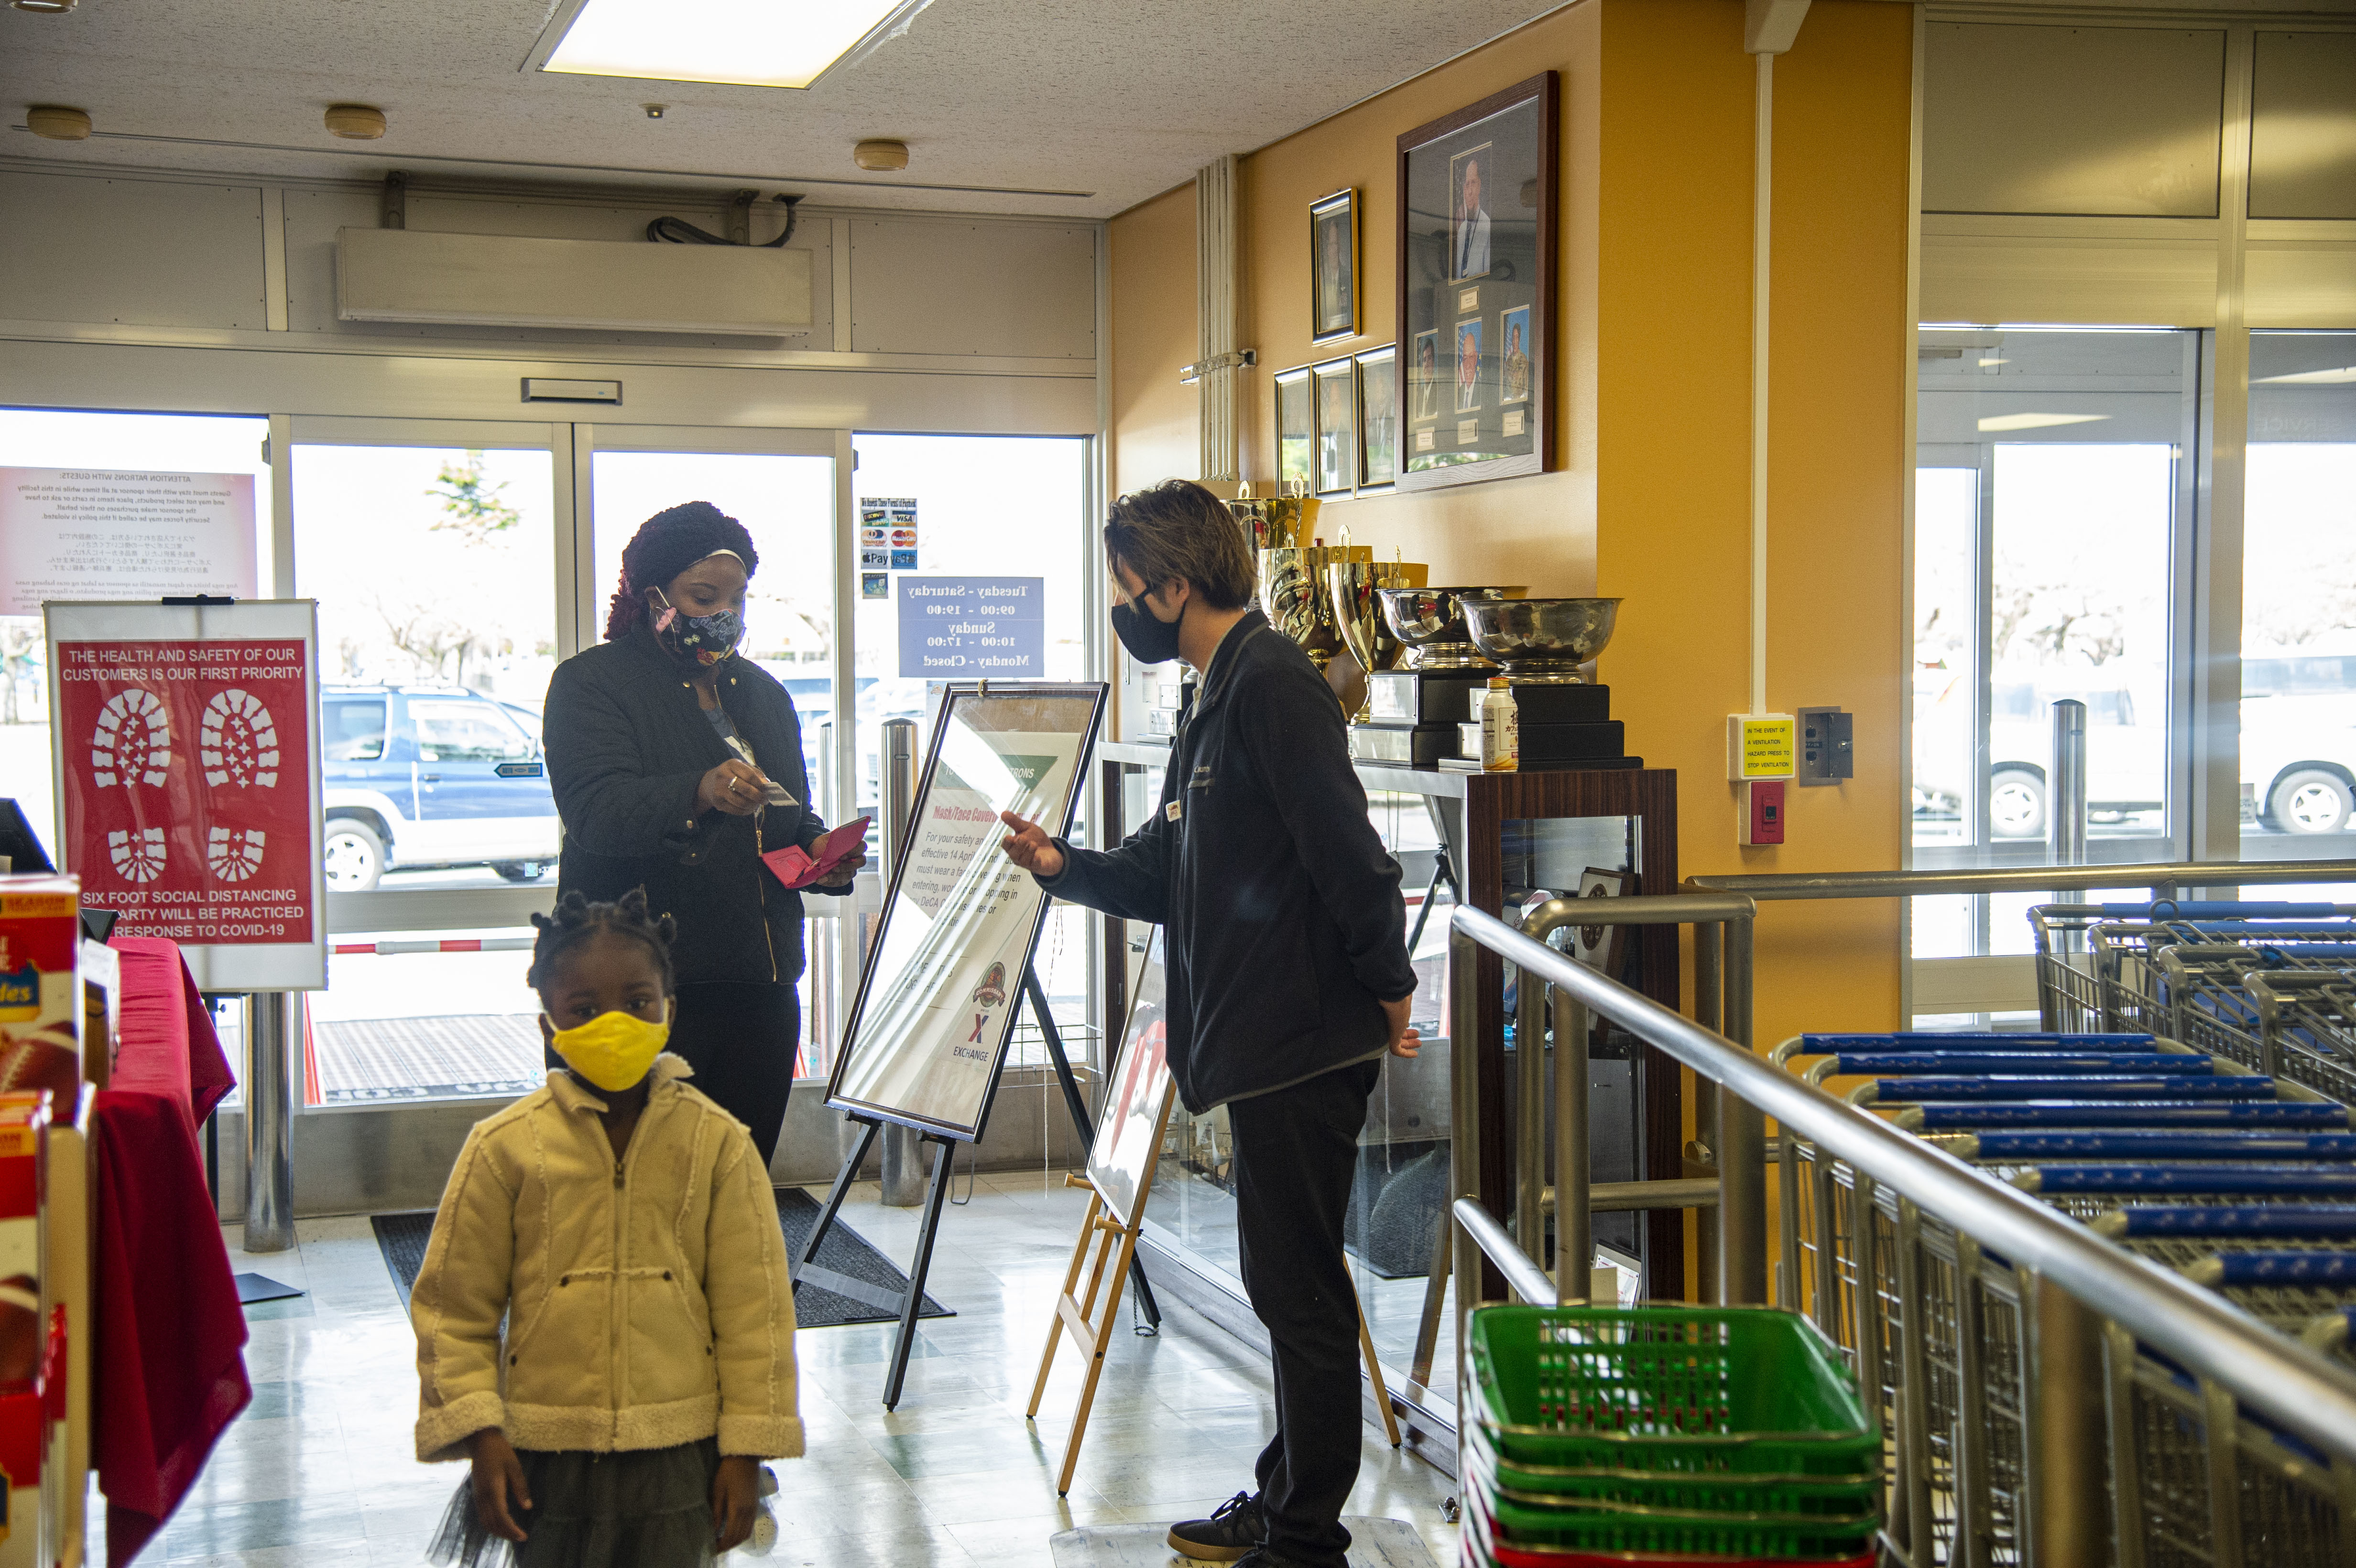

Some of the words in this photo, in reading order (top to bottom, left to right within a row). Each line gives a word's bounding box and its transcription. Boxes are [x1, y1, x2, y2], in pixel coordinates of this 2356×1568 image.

[871, 553, 888, 566] Pay
[69, 650, 96, 663] THE
[99, 650, 153, 662] HEALTH
[157, 650, 185, 662] AND
[189, 649, 240, 662] SAFETY
[244, 648, 262, 661] OF
[266, 648, 295, 661] OUR
[63, 668, 148, 681] CUSTOMERS
[152, 668, 164, 680] IS
[167, 668, 196, 680] OUR
[200, 667, 238, 680] FIRST
[241, 666, 303, 679] PRIORITY
[1010, 767, 1035, 779] TRONS
[932, 806, 971, 822] Mask/Face
[971, 807, 998, 823] Coveri
[926, 831, 937, 841] For
[937, 835, 953, 845] your
[954, 834, 974, 847] safety
[975, 837, 986, 846] an
[922, 848, 949, 859] effective
[950, 850, 958, 859] 14
[916, 865, 933, 874] must
[934, 867, 950, 876] wear
[82, 892, 105, 904] SIX
[109, 892, 148, 904] FOOT
[152, 891, 205, 903] SOCIAL
[209, 889, 296, 902] DISTANCING
[912, 881, 939, 894] entering,
[941, 883, 968, 896] worg
[969, 887, 977, 895] or
[978, 888, 1009, 901] opping
[1011, 889, 1017, 899] in
[118, 909, 157, 920] ARTY
[160, 908, 195, 920] WILL
[198, 908, 218, 919] BE
[222, 906, 304, 919] PRACTICED
[921, 896, 938, 908] DeCA
[988, 905, 996, 915] or
[114, 926, 193, 937] RESPONSE
[196, 925, 216, 936] TO
[220, 924, 284, 936] COVID-19
[976, 987, 1004, 999] COMMISSARY
[953, 1046, 989, 1062] EXCHANGE
